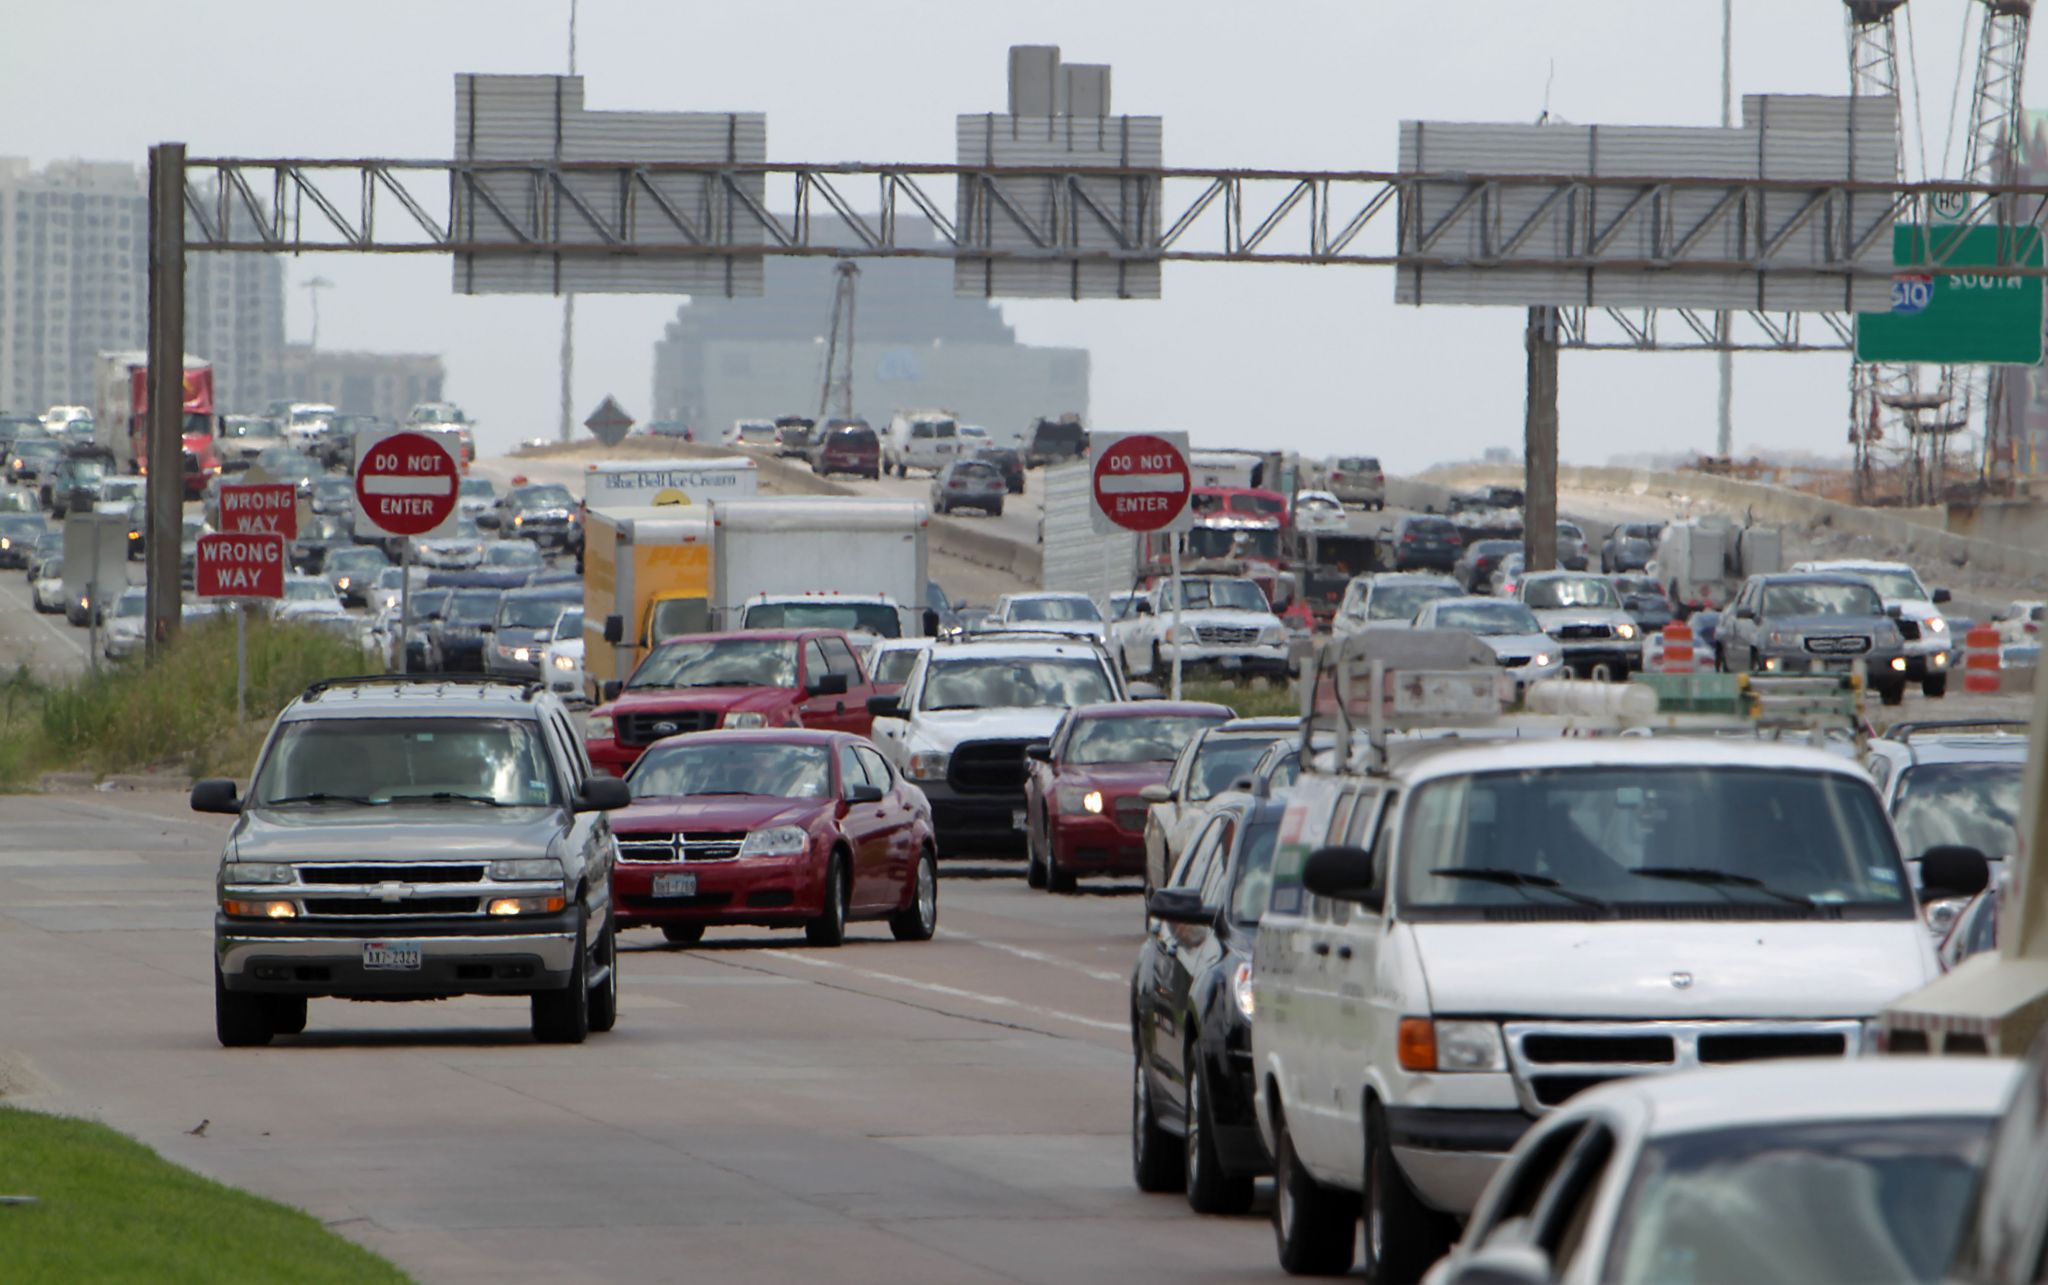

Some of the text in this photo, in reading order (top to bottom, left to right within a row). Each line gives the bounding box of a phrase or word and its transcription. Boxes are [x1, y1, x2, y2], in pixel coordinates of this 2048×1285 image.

[1939, 192, 1961, 210] HC
[1949, 273, 2022, 289] SOUTH
[375, 454, 443, 471] DO NOT
[1110, 454, 1173, 470] DO NOT
[606, 472, 736, 489] Blue Bell Ice Cream
[223, 491, 291, 511] WRONG
[380, 498, 434, 516] ENTER
[1116, 496, 1169, 512] ENTER
[237, 515, 279, 533] WAY
[201, 541, 279, 562] WRONG
[217, 568, 262, 588] WAY
